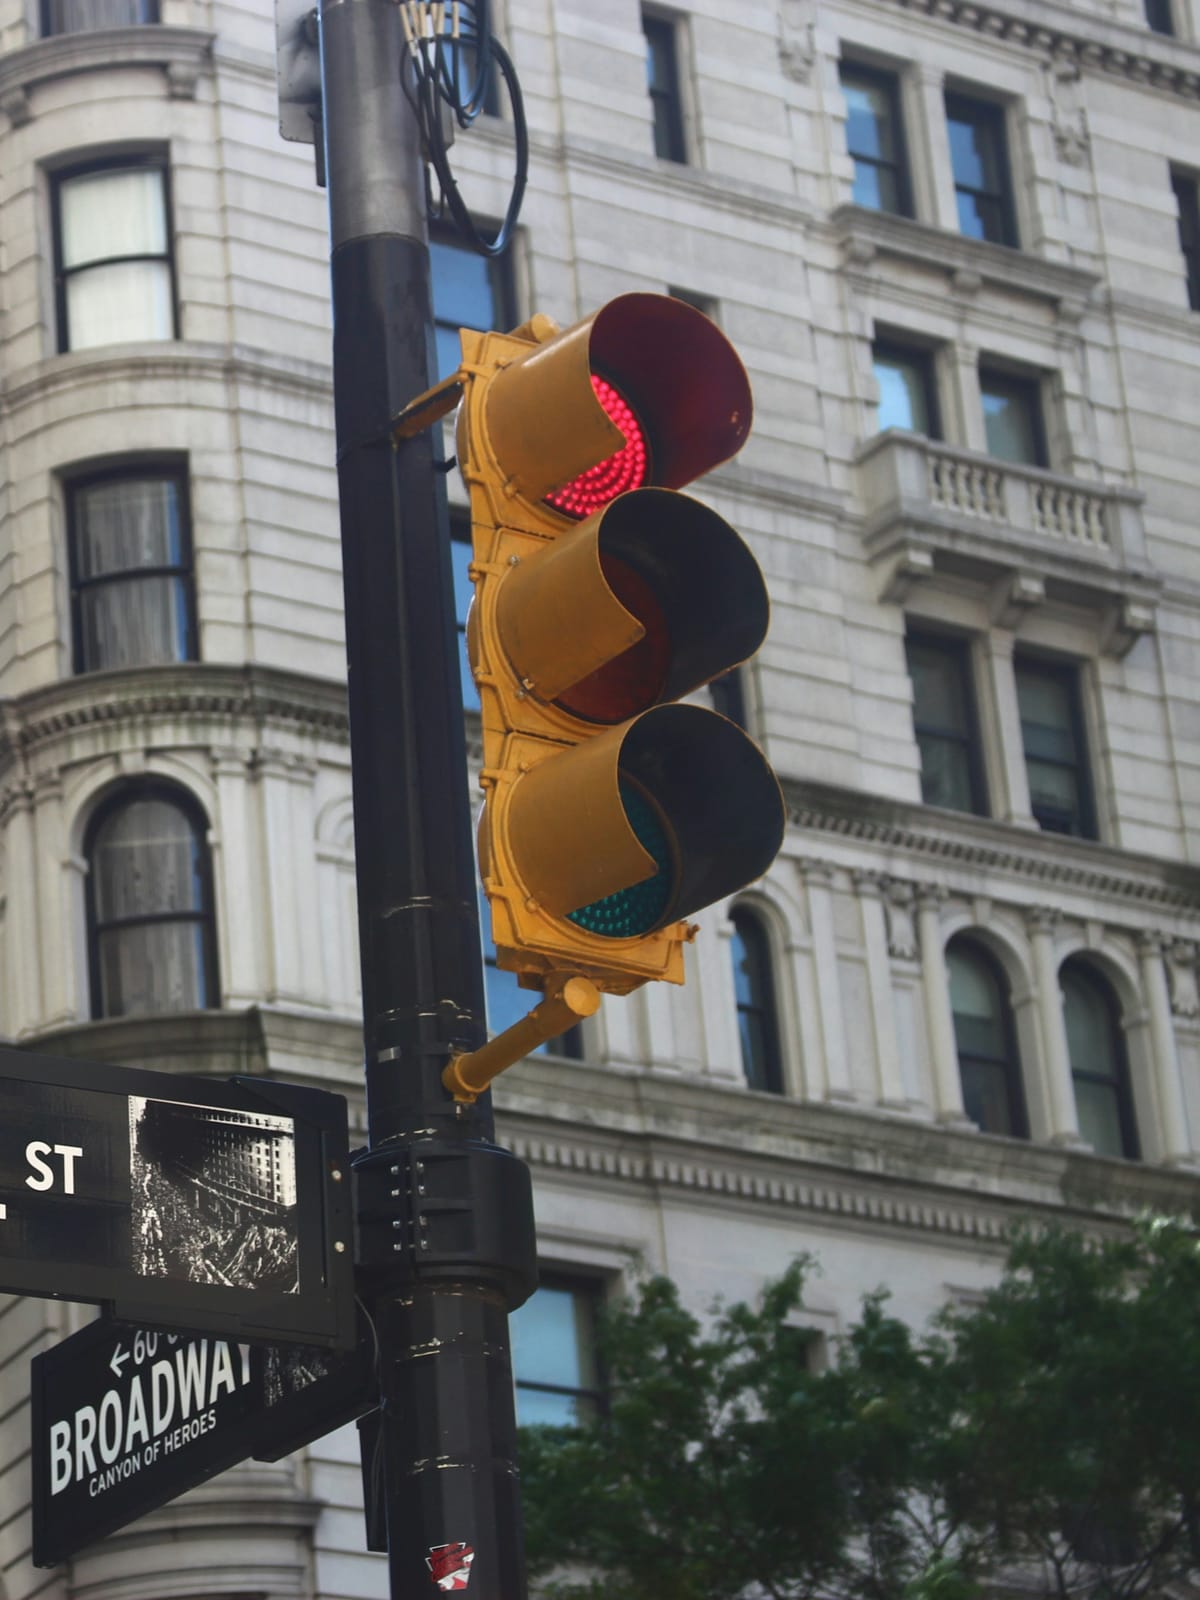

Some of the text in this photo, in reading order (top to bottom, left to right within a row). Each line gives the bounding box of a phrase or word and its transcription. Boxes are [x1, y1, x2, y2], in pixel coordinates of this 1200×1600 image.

[25, 1141, 83, 1195] ST
[89, 1409, 217, 1497] CANYON OF HEROES
